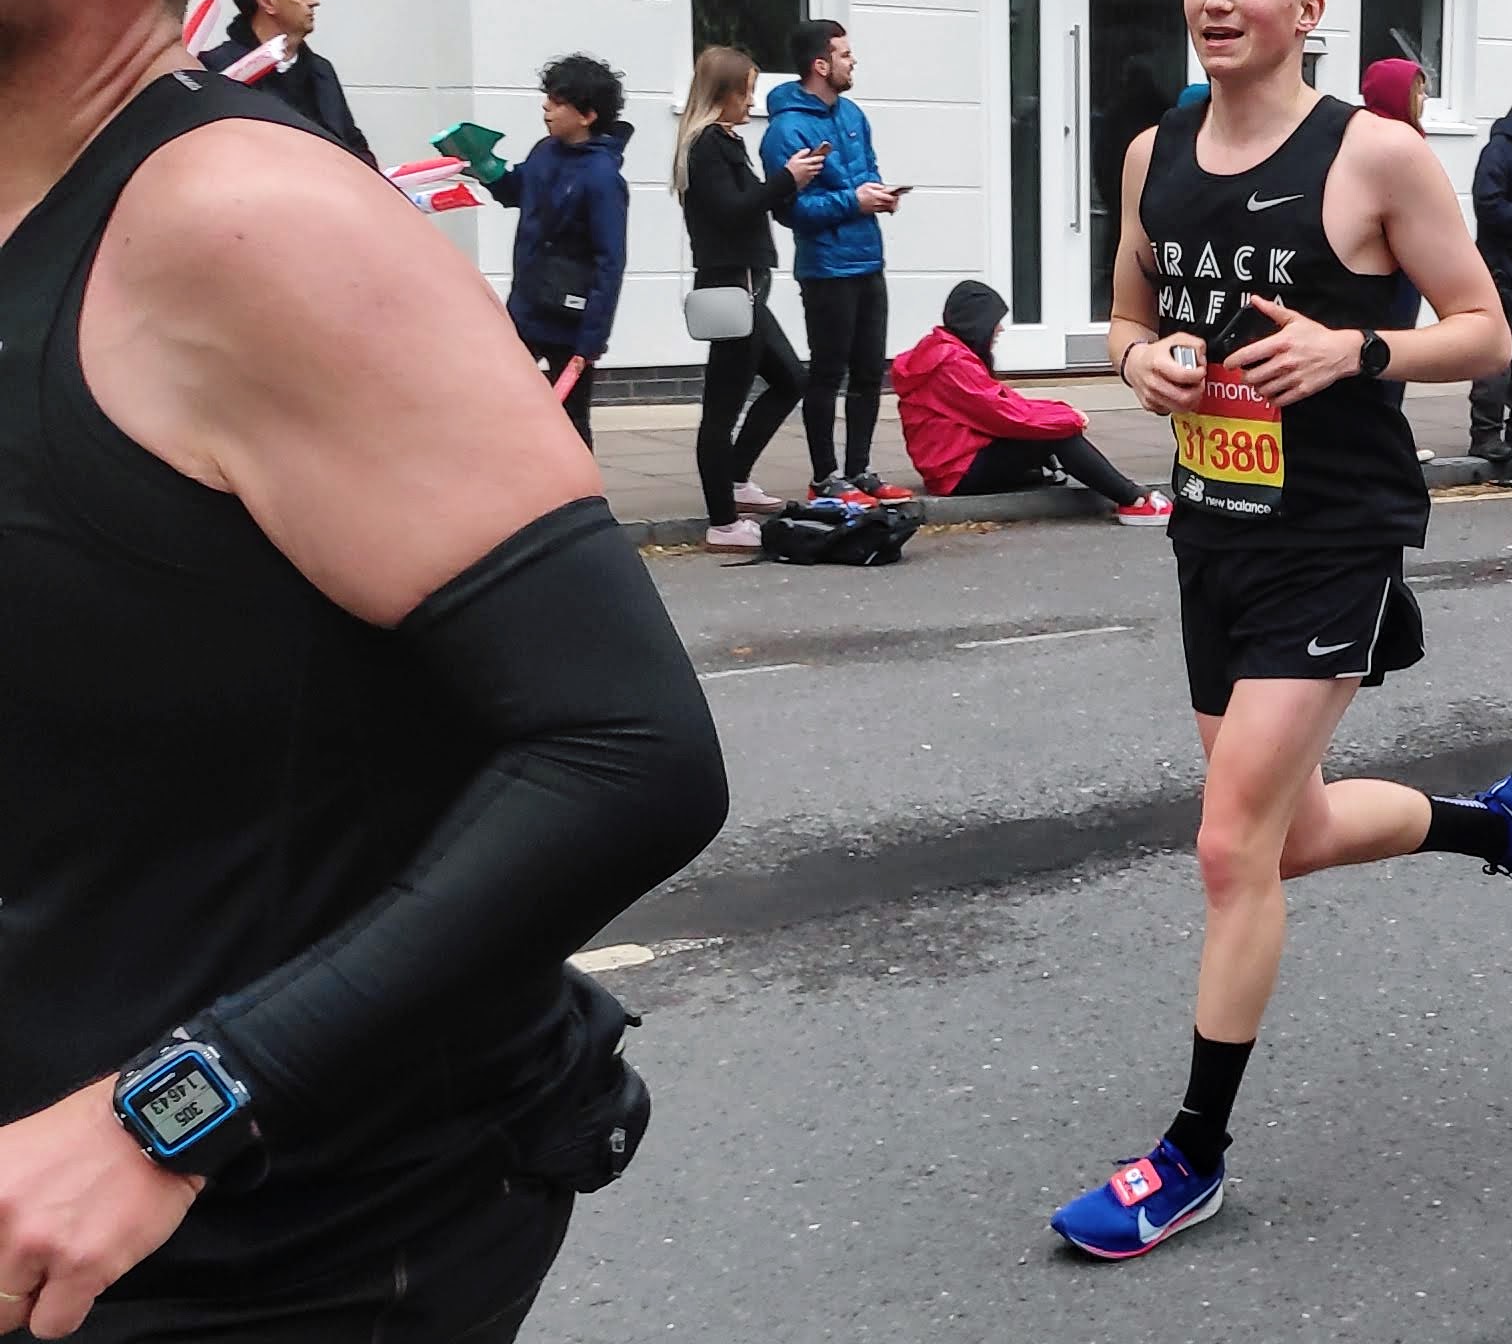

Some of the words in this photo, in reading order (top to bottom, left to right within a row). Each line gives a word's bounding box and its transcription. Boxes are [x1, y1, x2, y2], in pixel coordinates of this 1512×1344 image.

[1207, 381, 1271, 409] mone
[1182, 420, 1280, 475] 31380
[1205, 496, 1226, 509] new
[1226, 498, 1272, 515] balance
